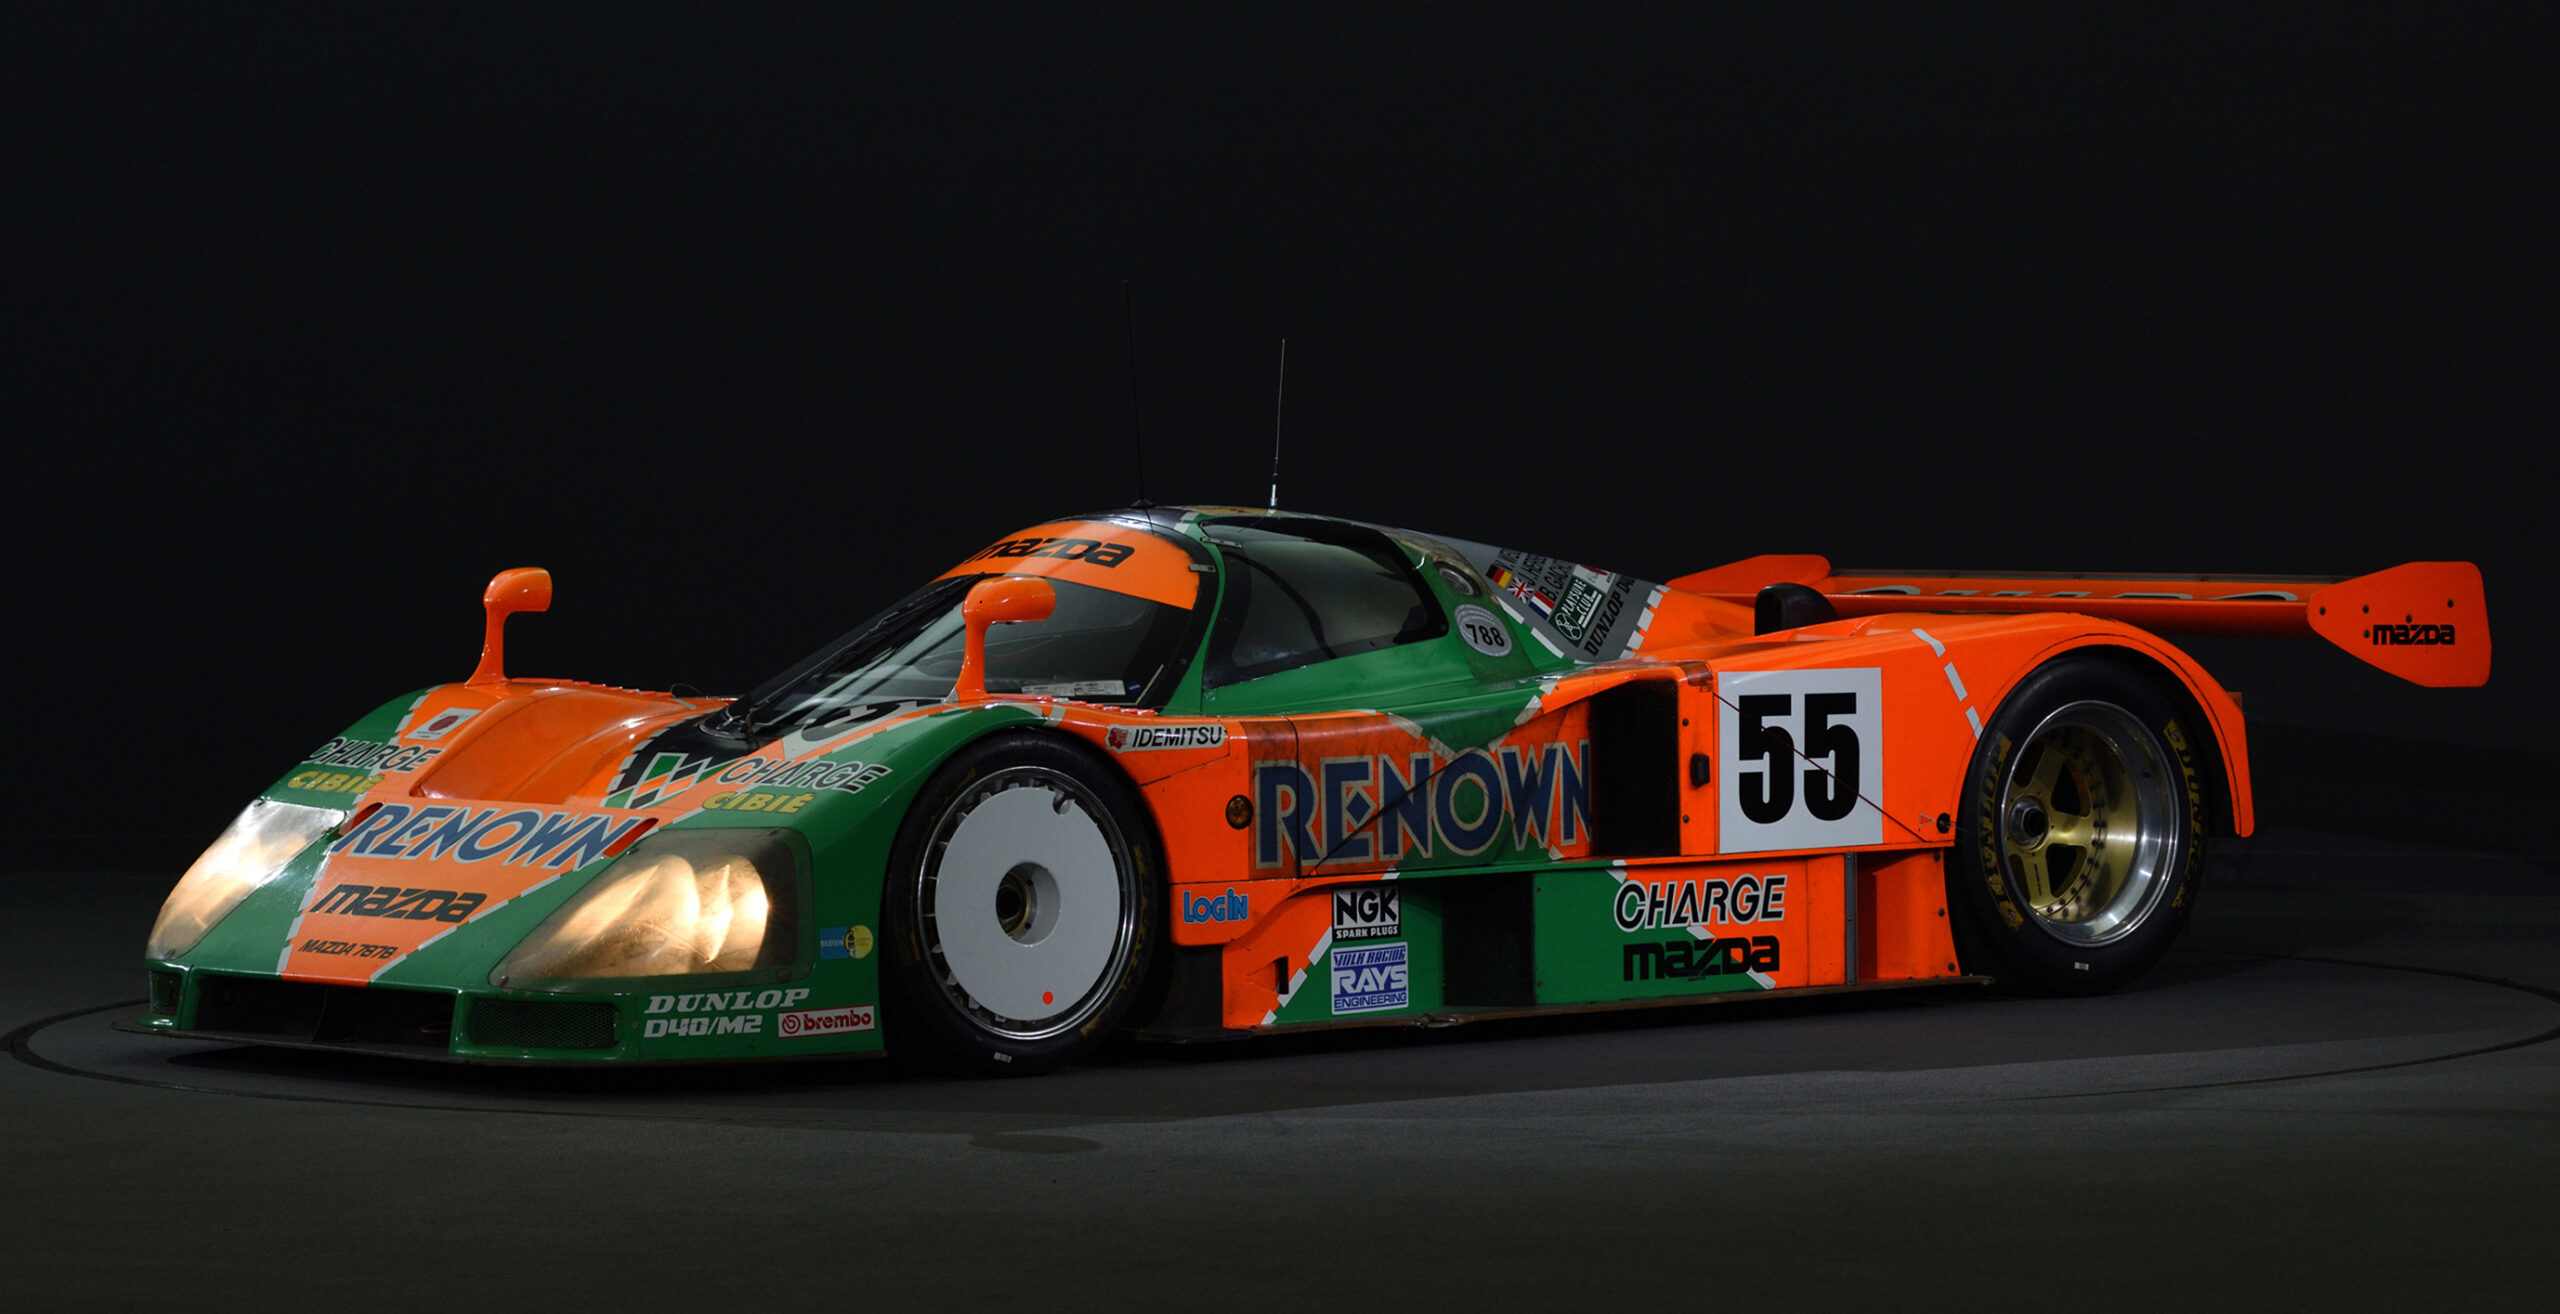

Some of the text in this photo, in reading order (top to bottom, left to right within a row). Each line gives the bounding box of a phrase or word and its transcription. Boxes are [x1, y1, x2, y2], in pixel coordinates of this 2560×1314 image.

[1560, 578, 1588, 617] PLAYSURE
[1576, 592, 1595, 616] CLUB
[1465, 623, 1505, 647] 788
[1584, 591, 1624, 657] DUNLOP
[1132, 725, 1224, 749] IDEMITSU
[304, 737, 445, 772] CHARGE
[1738, 692, 1860, 824] 55
[716, 755, 893, 795] CHARGE
[1254, 738, 1590, 869] RENOWN
[327, 803, 642, 871] RENOWN
[1336, 889, 1397, 926] NGK
[1613, 873, 1788, 932] CHARGE
[1336, 925, 1399, 940] SPARK PLUGS
[298, 939, 400, 960] MAZDA 787B
[1334, 948, 1407, 967] VOLK RACING
[1334, 964, 1407, 995] RAYS
[643, 988, 810, 1014] DUNLOP
[1334, 992, 1407, 1009] ENGINEERING
[643, 1014, 763, 1038] D40/M2
[803, 1010, 872, 1031] brembo
